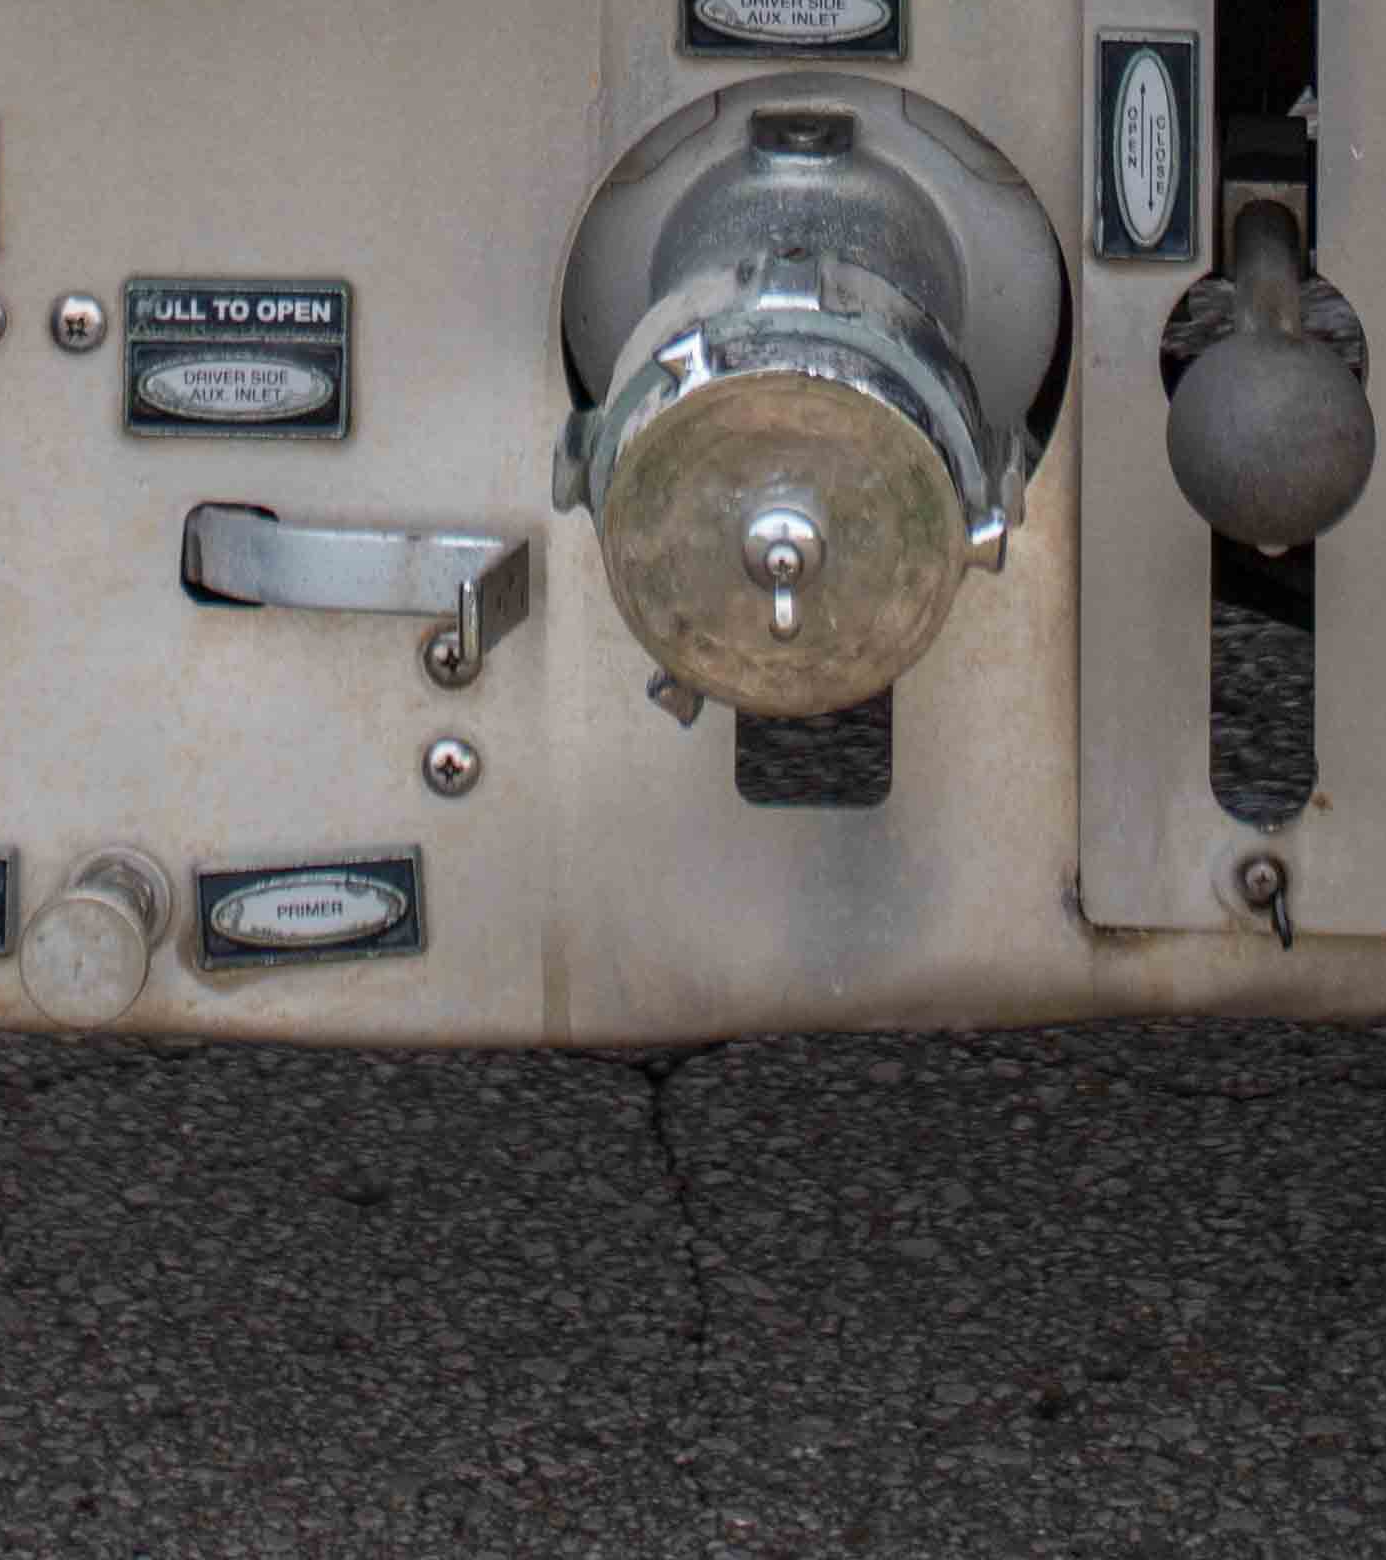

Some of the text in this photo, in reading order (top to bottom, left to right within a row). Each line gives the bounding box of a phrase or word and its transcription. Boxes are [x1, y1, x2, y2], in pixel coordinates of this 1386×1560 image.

[792, 11, 840, 26] INLET
[136, 299, 332, 323] PULL TO OPEN
[184, 370, 289, 386] DRIVER SIDE
[234, 387, 281, 403] INLET
[276, 900, 343, 920] PRIMER
